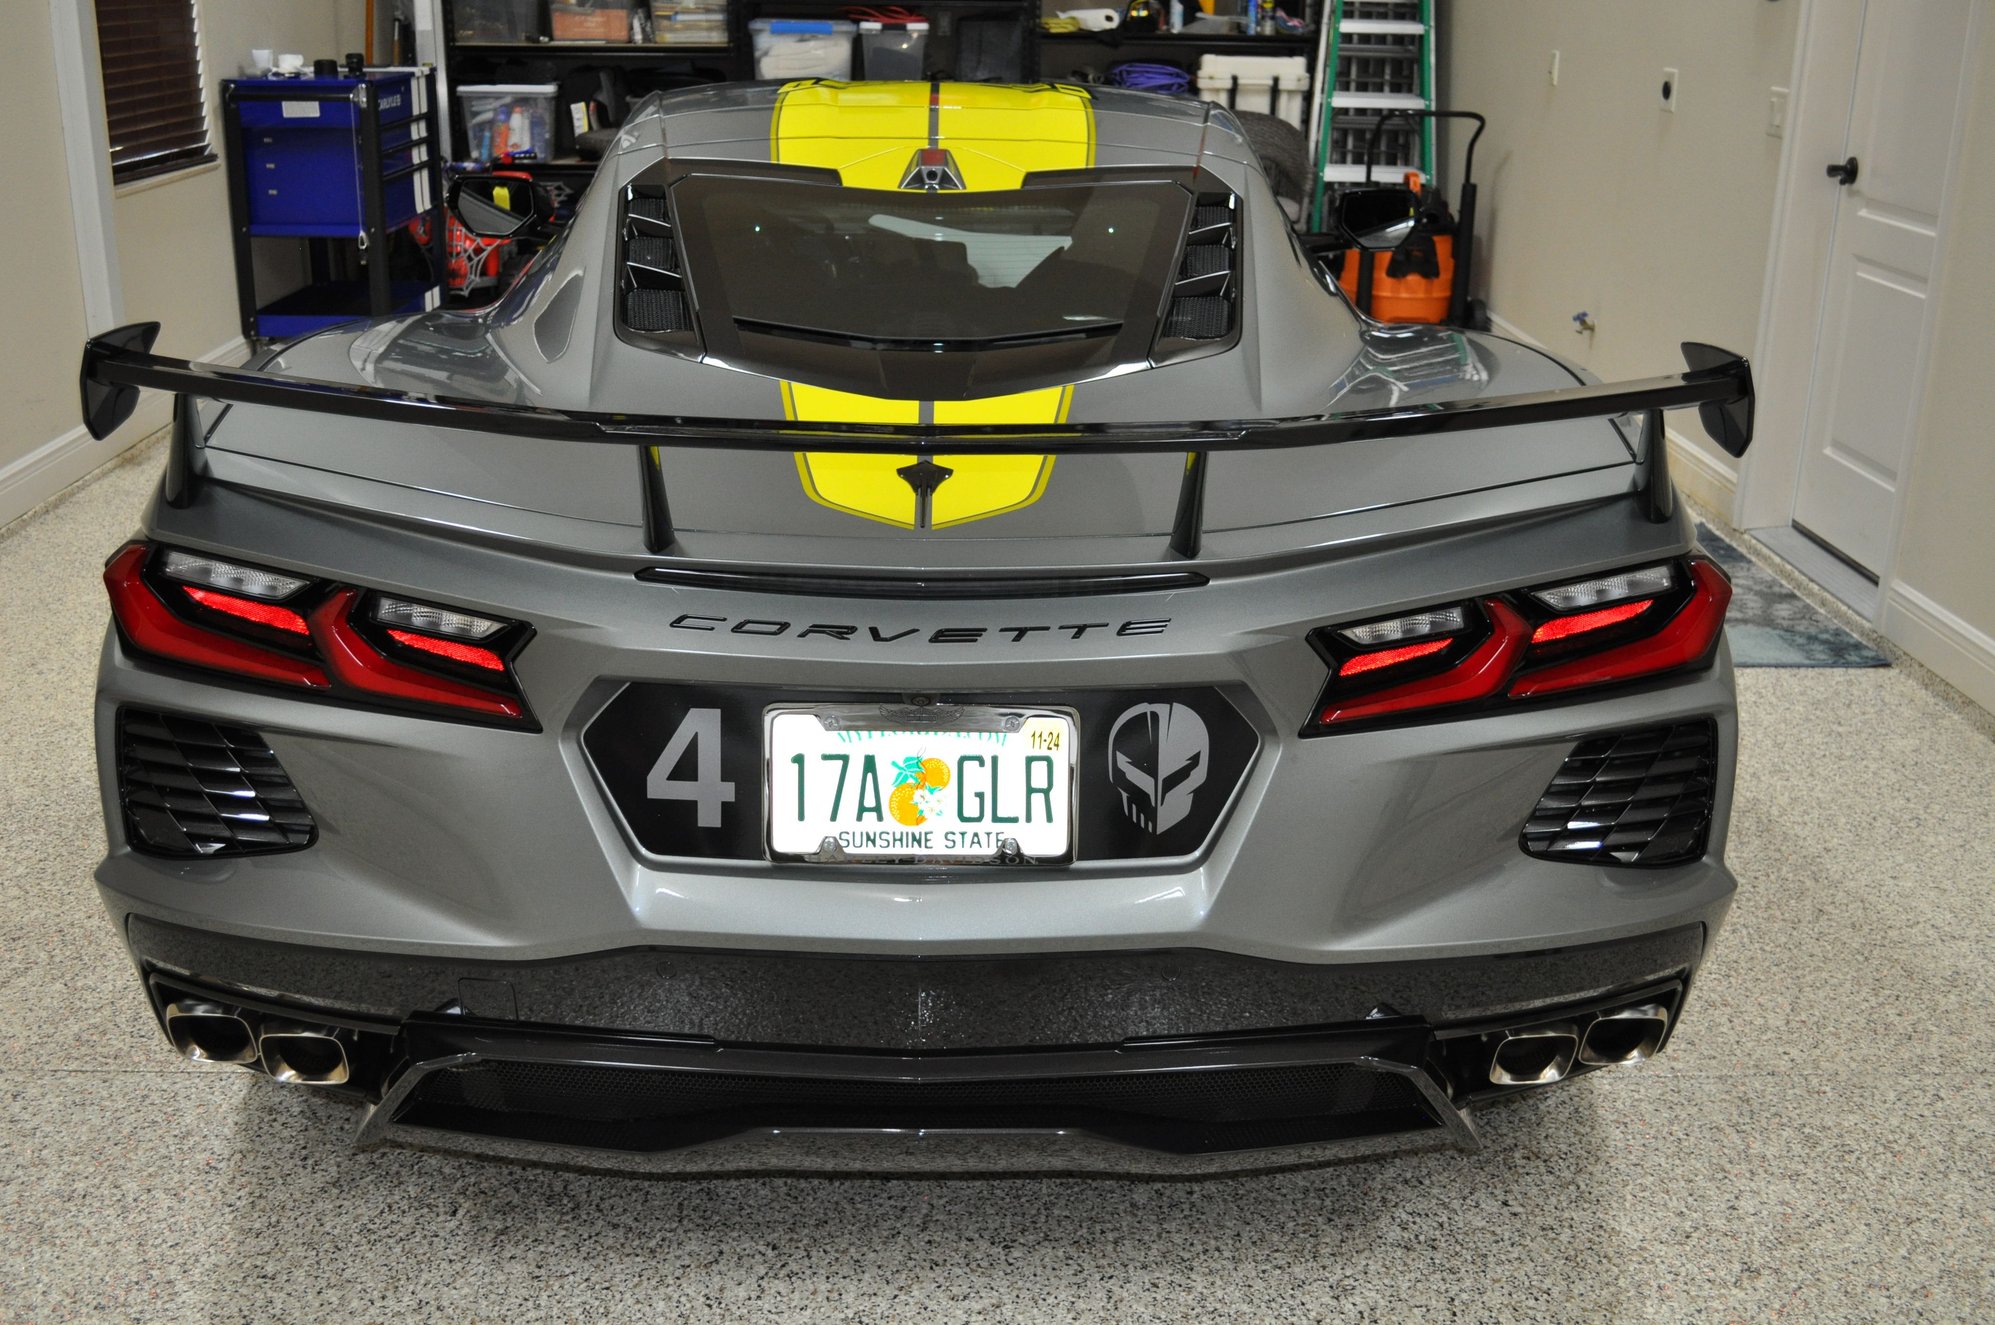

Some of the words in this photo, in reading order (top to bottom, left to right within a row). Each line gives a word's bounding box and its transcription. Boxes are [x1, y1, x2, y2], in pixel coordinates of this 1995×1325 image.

[669, 613, 1172, 643] CORVETTE
[646, 708, 736, 828] 4
[790, 752, 884, 823] 17A
[956, 754, 1054, 824] GLR
[838, 830, 934, 849] SUNSHINE
[944, 831, 1005, 849] STATE
